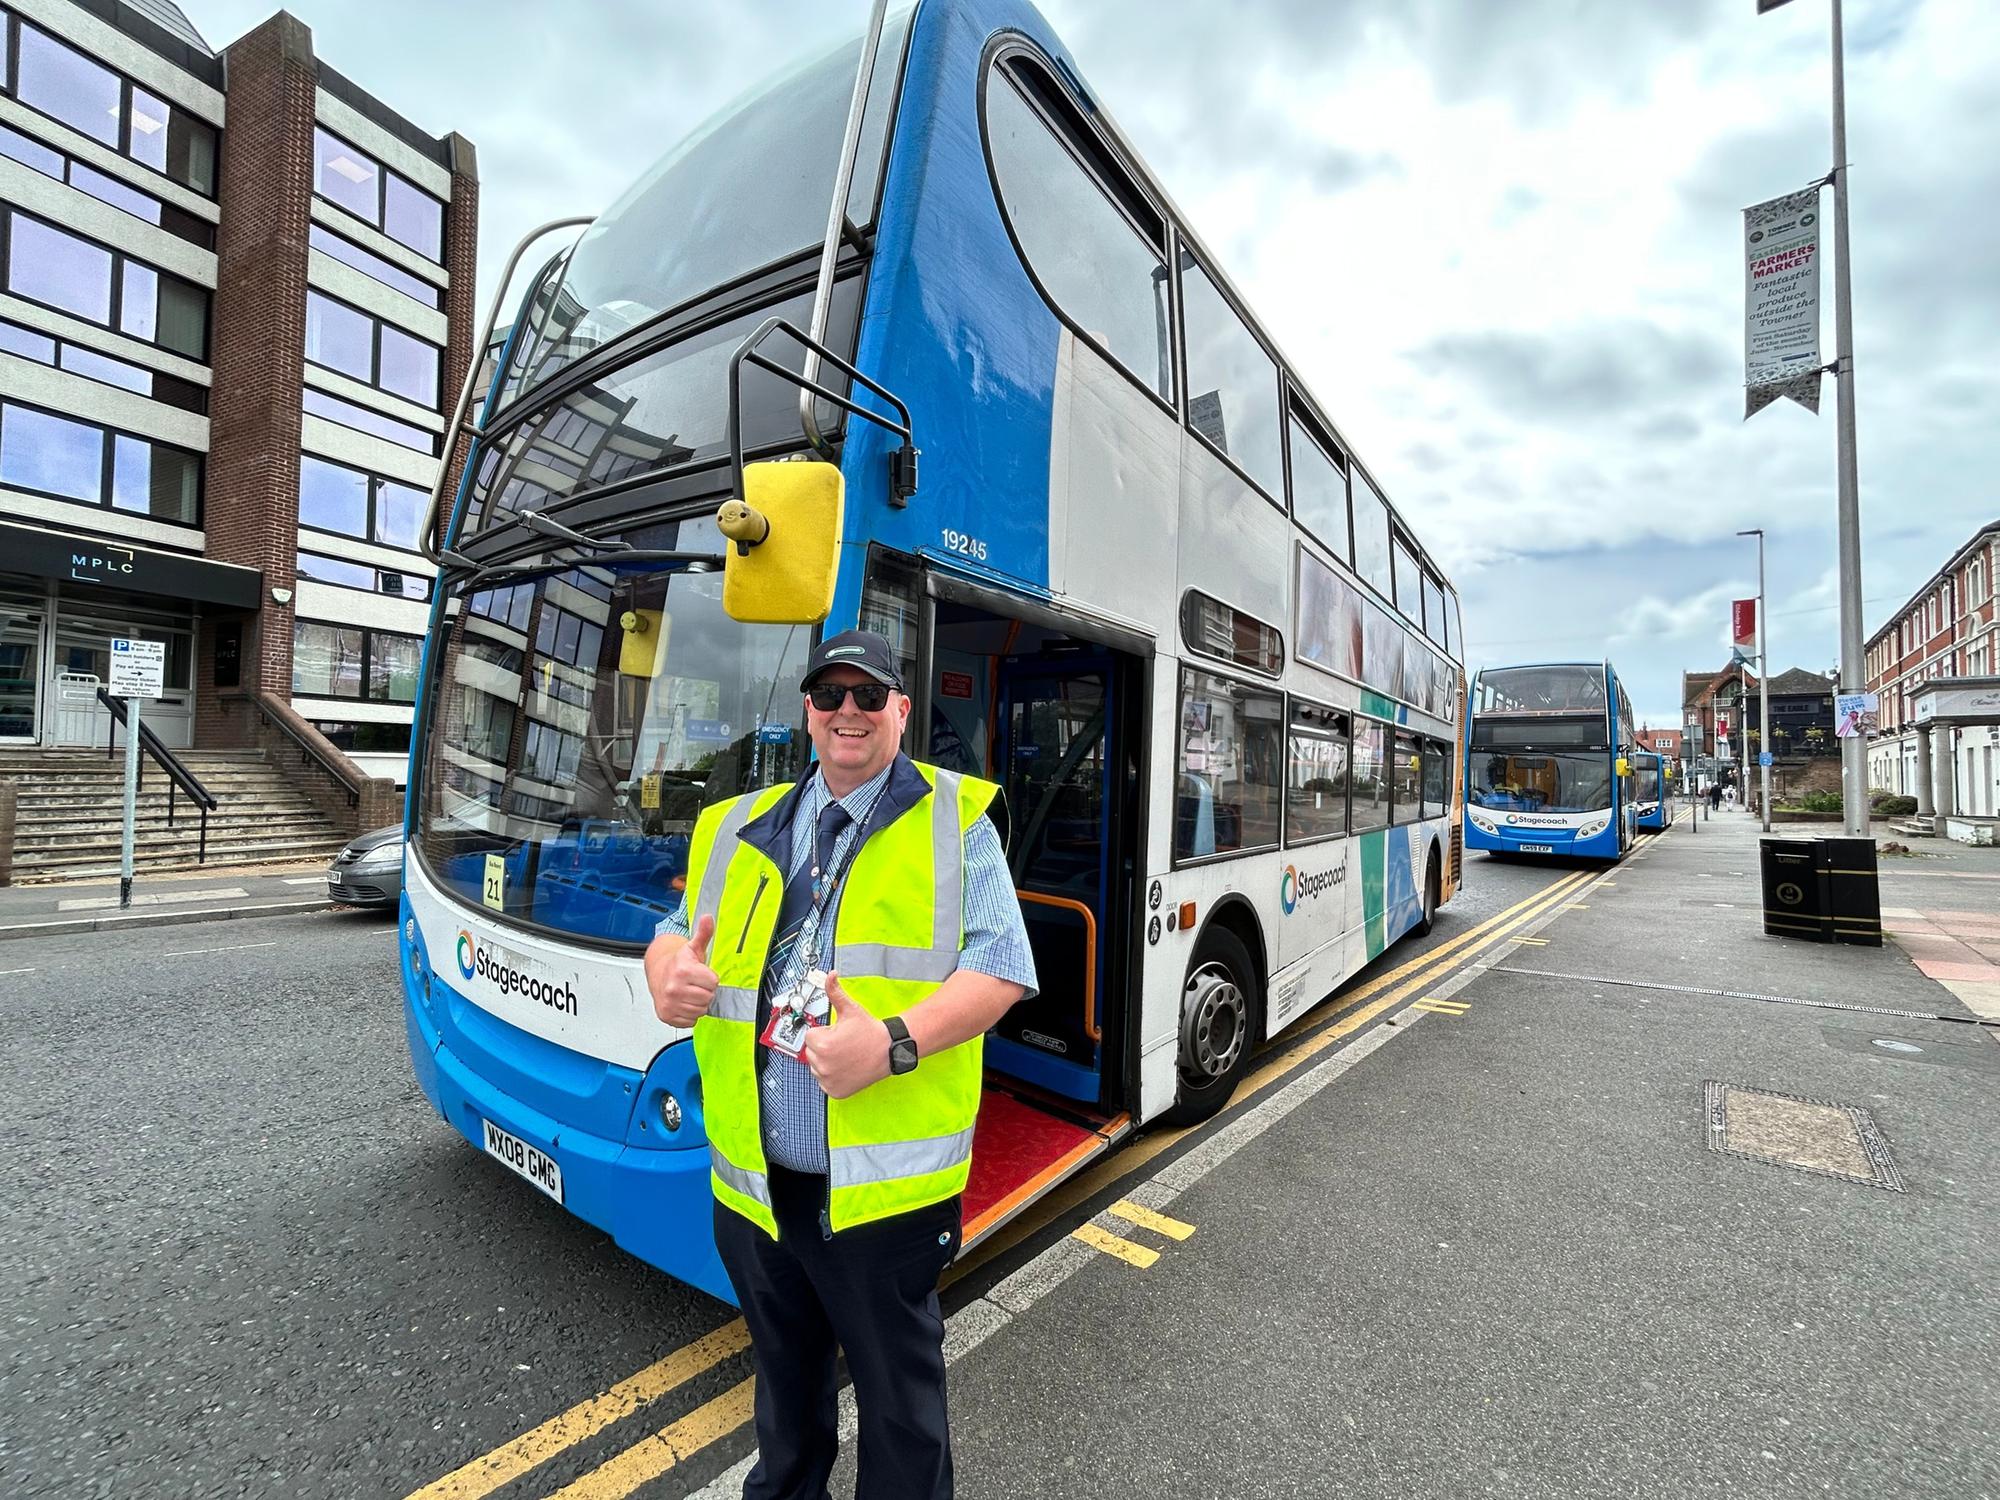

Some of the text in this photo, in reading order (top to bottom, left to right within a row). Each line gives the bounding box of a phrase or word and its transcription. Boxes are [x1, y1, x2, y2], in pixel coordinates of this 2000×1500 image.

[1750, 243, 1816, 271] FARMERS
[1754, 254, 1813, 279] MARKET
[1753, 269, 1812, 291] Fantastic
[1767, 281, 1798, 297] local
[1749, 298, 1816, 321] outside the
[1757, 291, 1806, 311] produce
[1760, 310, 1806, 327] Towner
[942, 528, 987, 560] 19245
[72, 554, 133, 573] MPLC
[117, 641, 128, 650] P
[1840, 703, 1865, 717] gum
[1518, 814, 1568, 826] Stagecoach
[487, 877, 500, 902] 21
[1298, 858, 1346, 899] Stagecoach
[476, 946, 578, 1017] Stagecoach
[528, 1148, 556, 1191] GMG
